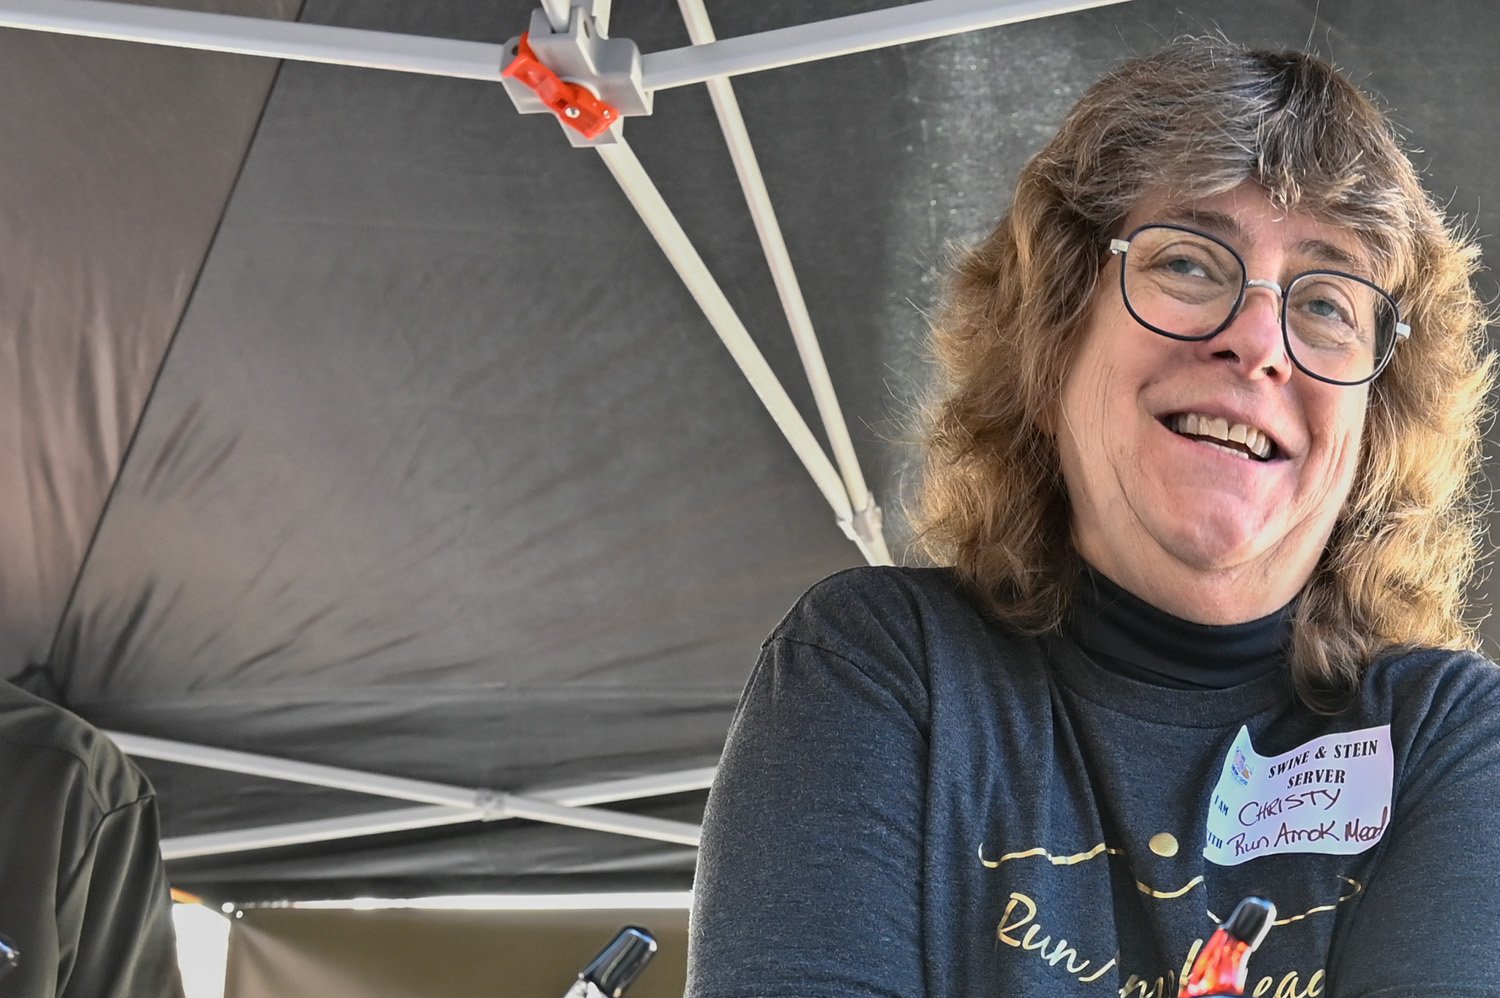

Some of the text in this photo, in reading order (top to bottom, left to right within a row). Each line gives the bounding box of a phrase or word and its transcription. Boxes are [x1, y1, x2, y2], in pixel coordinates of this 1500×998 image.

[1267, 749, 1311, 779] SWINE
[1314, 745, 1328, 760] &
[1333, 739, 1379, 760] STEIN
[1286, 769, 1346, 789] SERVER
[1238, 788, 1341, 827] CHRISTY
[1226, 831, 1270, 857] Run
[995, 891, 1090, 974] Run
